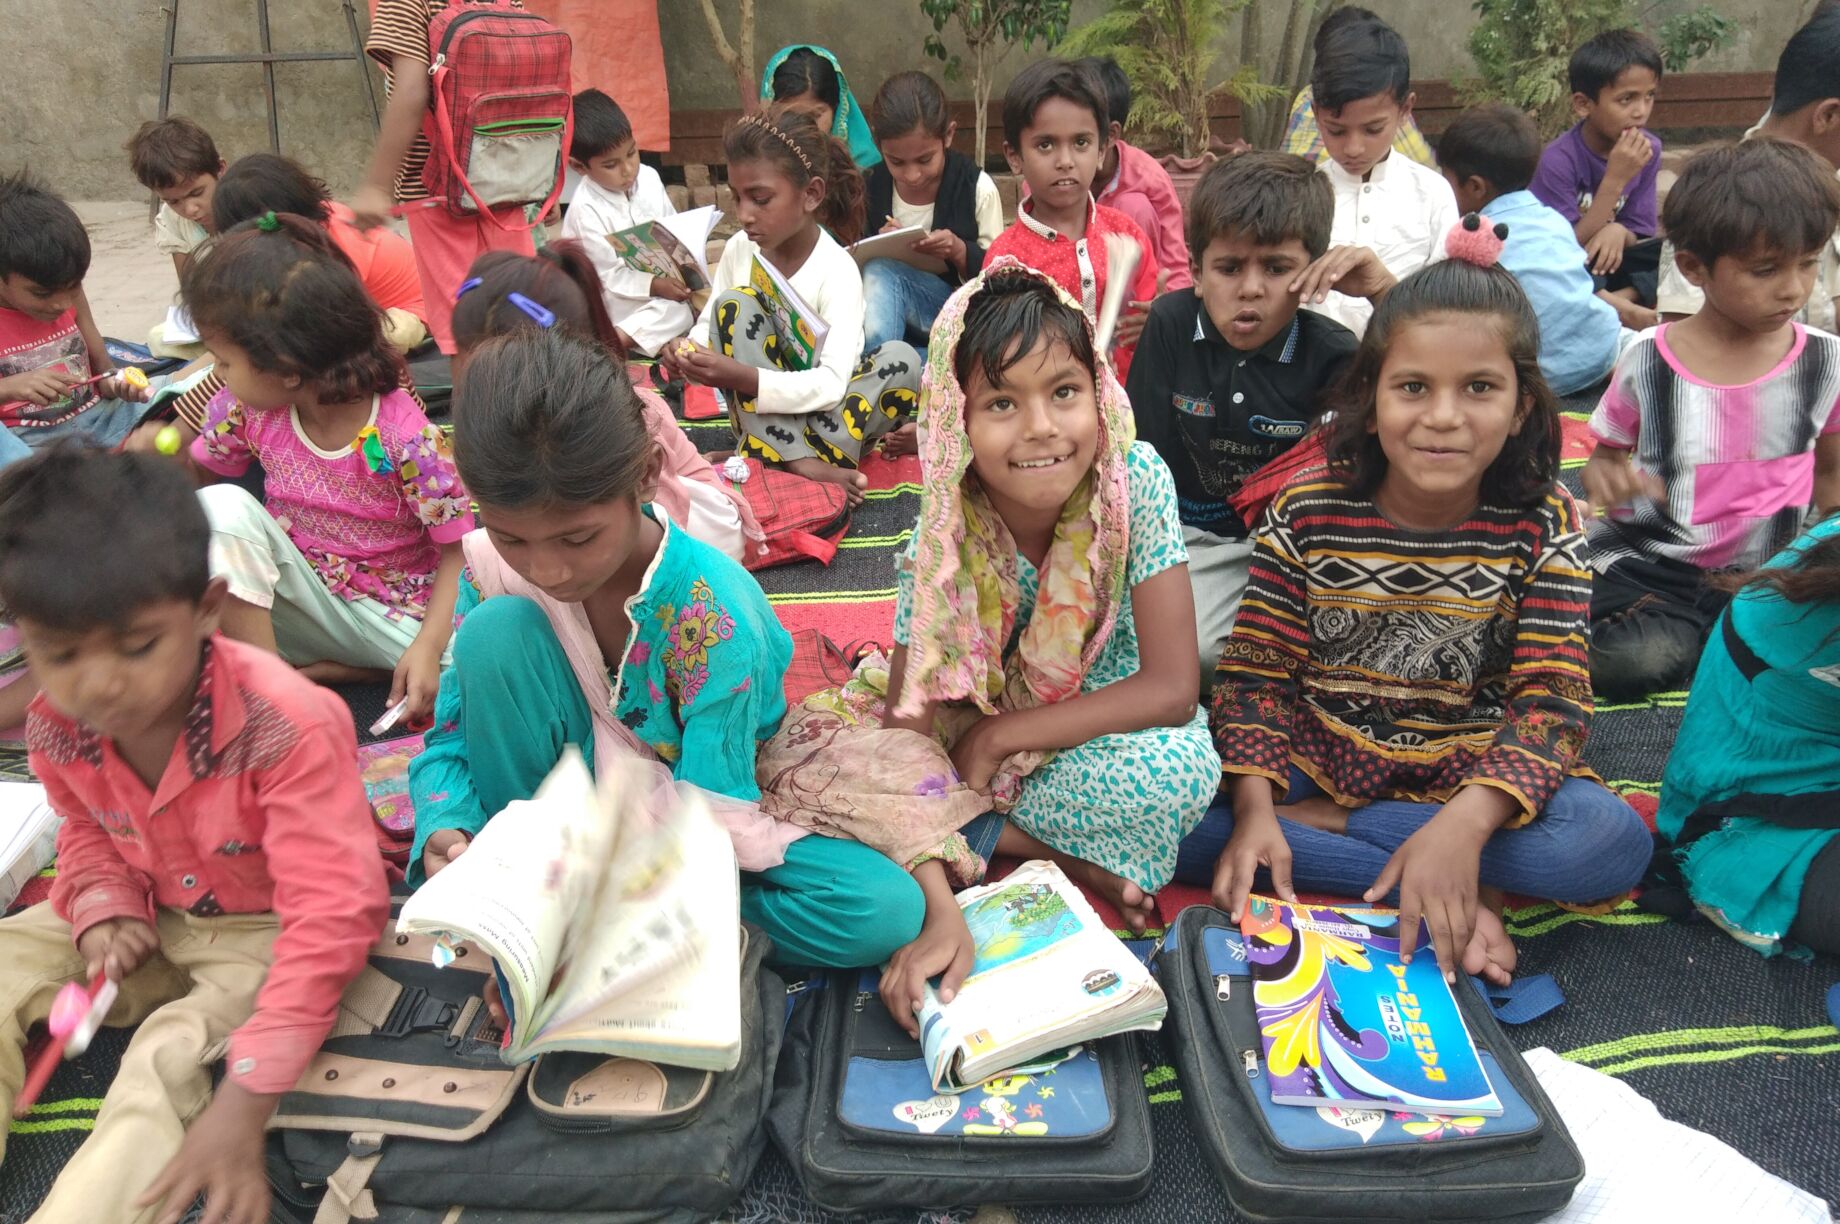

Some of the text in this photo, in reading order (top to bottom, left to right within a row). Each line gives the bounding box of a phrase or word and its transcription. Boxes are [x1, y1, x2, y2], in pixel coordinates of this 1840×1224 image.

[1380, 995, 1405, 1043] NOTES
[1387, 964, 1447, 1083] RAHMANIA
[911, 1108, 953, 1121] Twety
[1341, 1111, 1382, 1127] Twety
